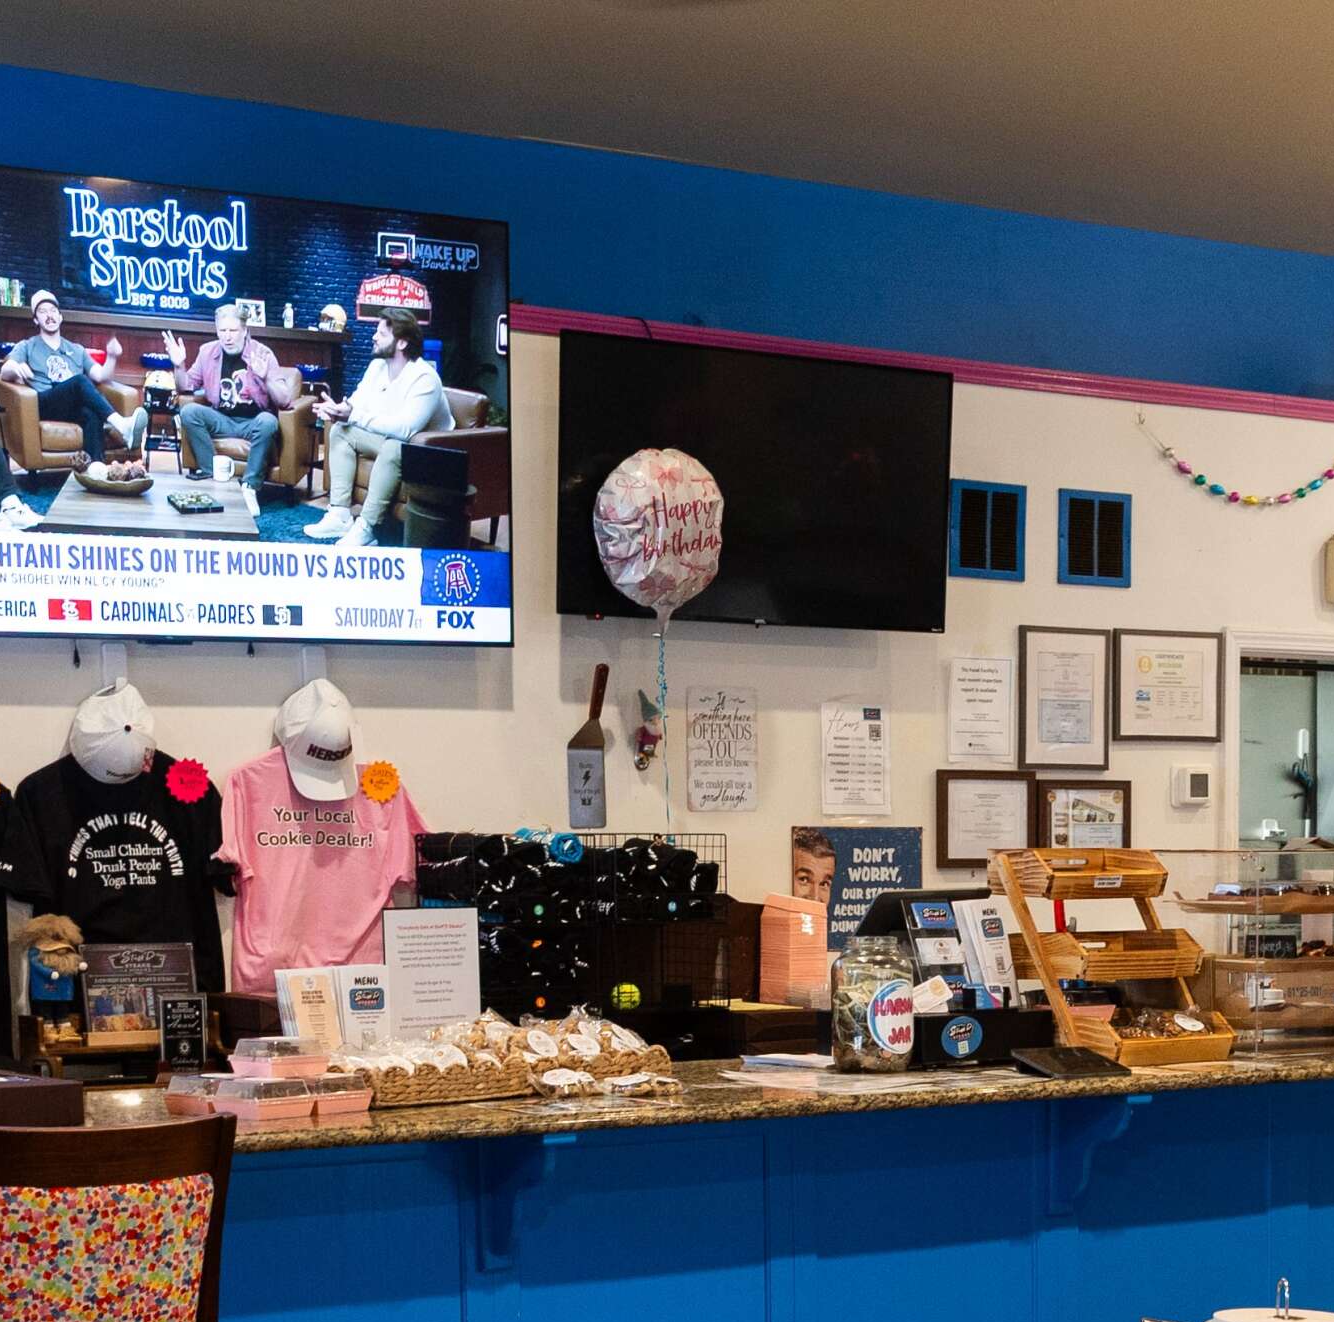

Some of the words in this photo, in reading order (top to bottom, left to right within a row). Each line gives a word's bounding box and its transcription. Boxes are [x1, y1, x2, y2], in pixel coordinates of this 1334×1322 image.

[64, 187, 248, 250] Barstool
[416, 244, 453, 261] WAKE
[455, 248, 476, 262] UP
[89, 238, 228, 304] Sports
[130, 294, 156, 307] EST
[159, 296, 190, 309] 2003
[651, 492, 714, 529] Happy
[642, 528, 722, 562] birthda
[68, 545, 144, 572] SHINES
[150, 548, 177, 573] ON
[183, 550, 220, 575] THE
[227, 552, 299, 578] MOUND
[305, 554, 328, 579] VS
[333, 556, 405, 580] ASTROS
[10, 573, 54, 585] SHOHEI
[57, 575, 81, 587] WIN
[120, 577, 166, 589] YOUNG?
[100, 600, 186, 624] CARDINALS
[197, 603, 256, 626] PADRES
[334, 607, 404, 630] SATURDAY
[406, 609, 416, 630] 7
[436, 610, 476, 630] FOX
[692, 723, 752, 740] OFFENDS
[707, 740, 738, 759] YOU
[273, 807, 310, 824] Your
[315, 807, 356, 824] Local
[69, 827, 91, 862] THINGS
[87, 813, 118, 833] THAT
[123, 811, 148, 830] TELL
[150, 819, 169, 844] THE
[163, 837, 185, 876] TRUTH
[257, 830, 313, 847] Cookie
[314, 830, 374, 848] Dealer!
[85, 844, 116, 860] Small
[118, 842, 164, 858] Children
[852, 847, 896, 864] DON'T
[92, 860, 127, 874] Drunk
[128, 857, 162, 875] People
[848, 866, 903, 884] WORRY,
[100, 873, 128, 890] Yoga
[128, 872, 157, 886] Pants
[842, 887, 865, 901] OUR
[834, 903, 871, 918] ACCUS
[354, 976, 379, 986] MENU
[888, 1025, 912, 1046] JAR
